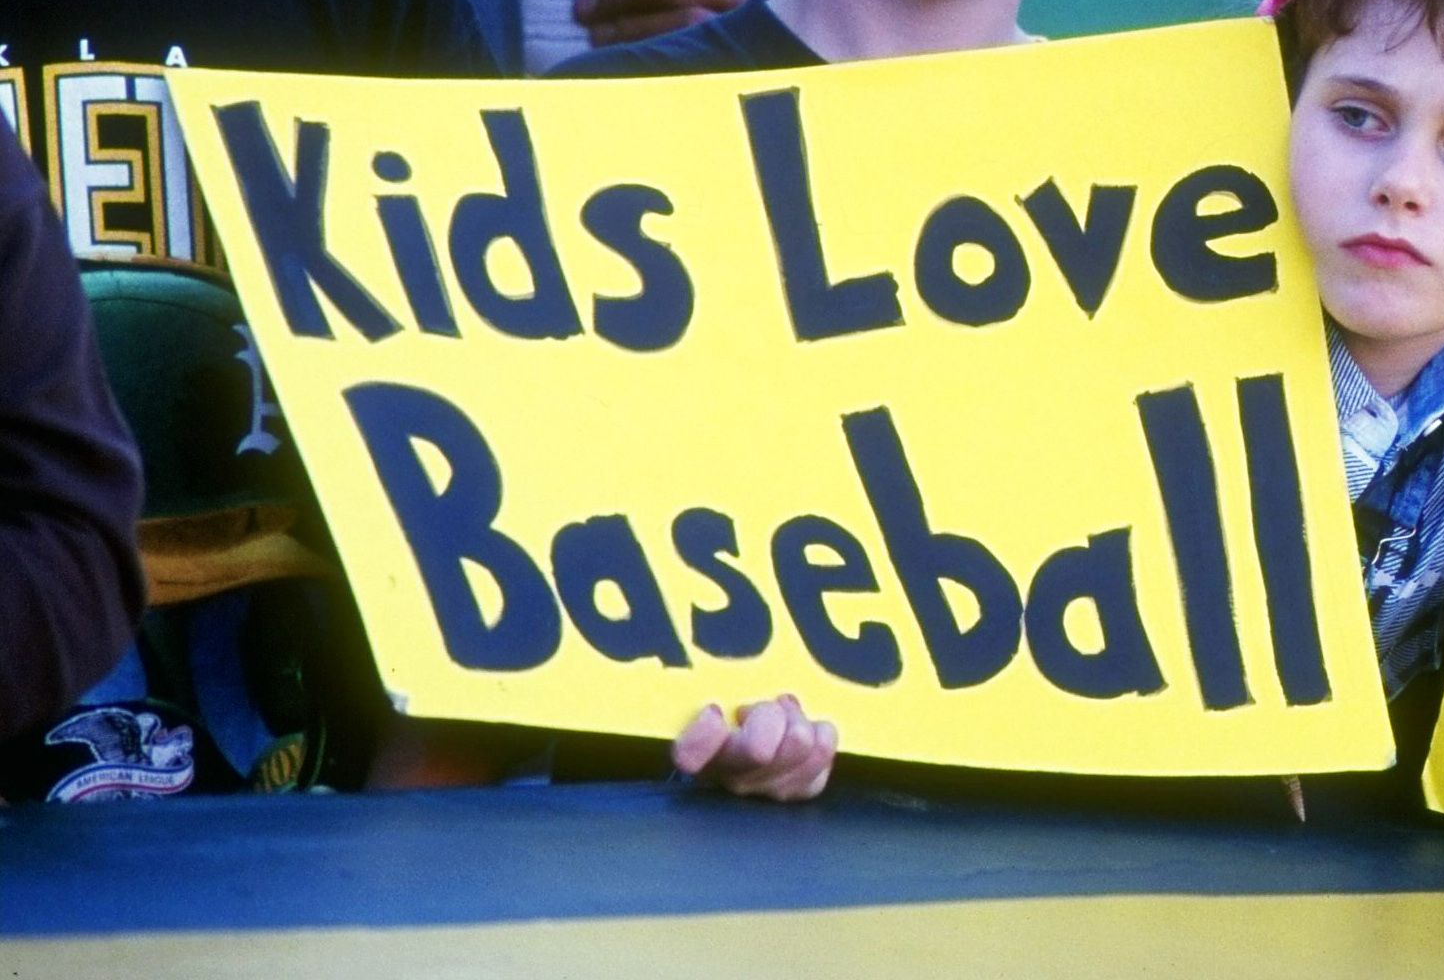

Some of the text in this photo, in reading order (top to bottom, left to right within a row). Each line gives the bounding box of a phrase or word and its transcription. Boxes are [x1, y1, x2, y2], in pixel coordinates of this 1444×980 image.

[209, 86, 1281, 354] Kids Love
[340, 372, 1334, 712] Baseball
